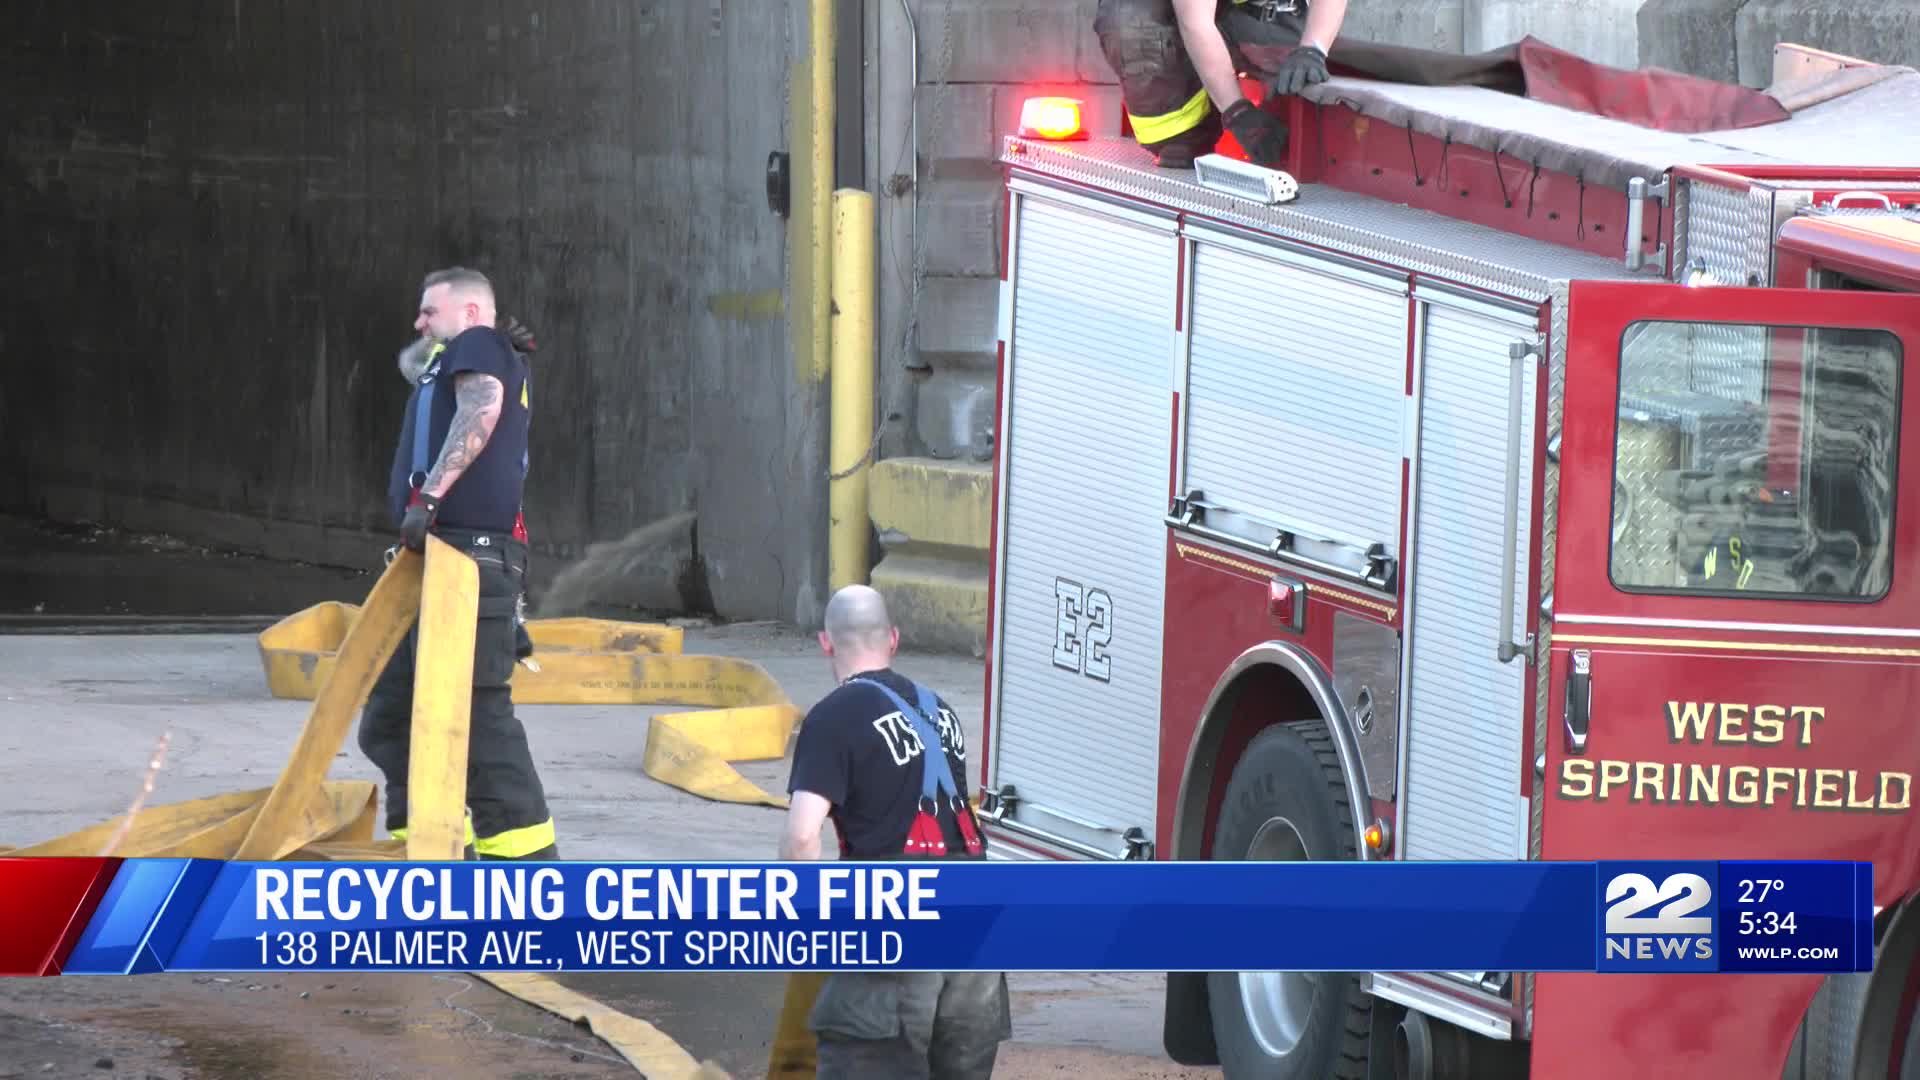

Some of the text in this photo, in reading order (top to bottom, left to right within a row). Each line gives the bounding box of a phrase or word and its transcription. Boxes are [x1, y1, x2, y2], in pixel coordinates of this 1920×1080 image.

[1053, 575, 1113, 684] E2
[1665, 700, 1825, 746] WEST
[1560, 758, 1912, 810] SPRINGFIELD
